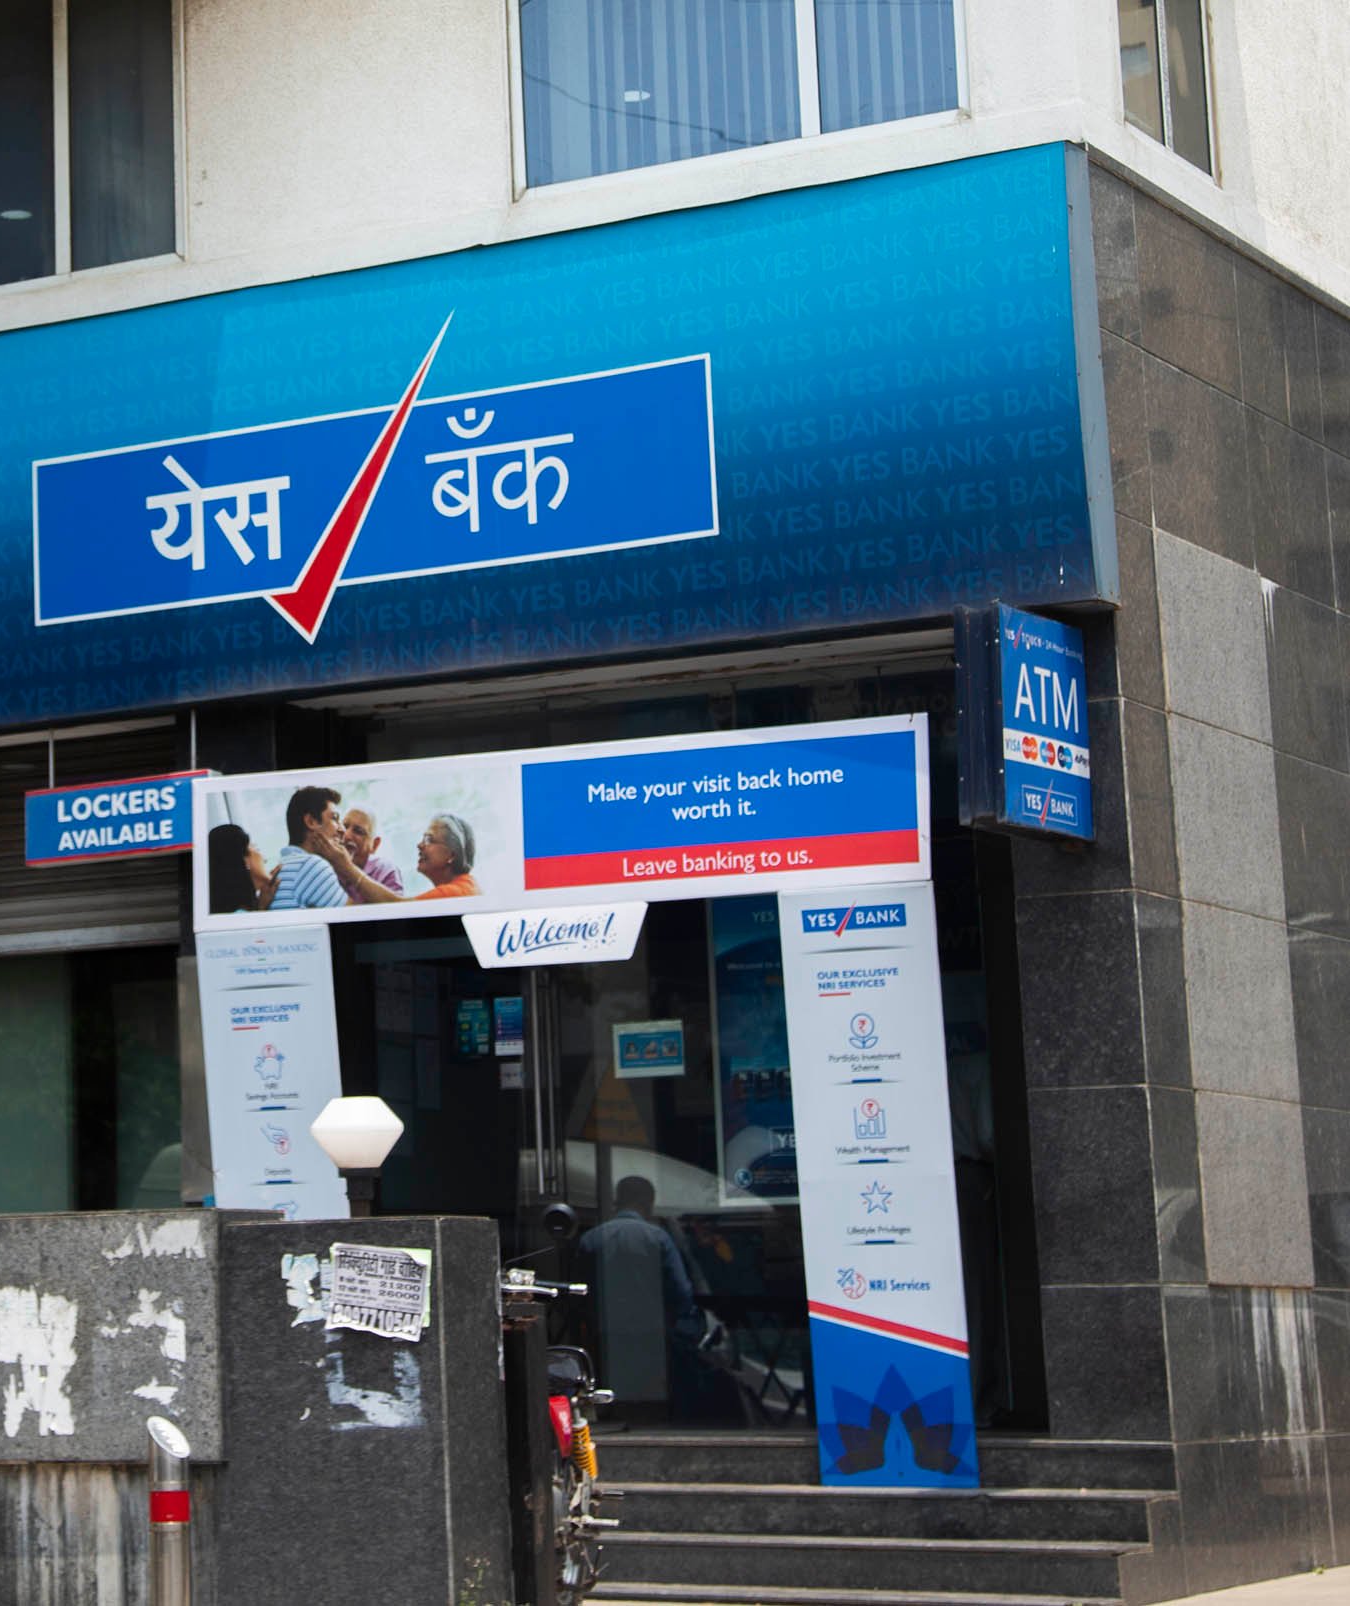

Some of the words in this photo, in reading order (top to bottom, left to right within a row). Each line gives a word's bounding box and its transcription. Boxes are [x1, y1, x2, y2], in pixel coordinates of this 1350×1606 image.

[752, 247, 811, 283] YES
[820, 230, 912, 272] BANK
[922, 218, 982, 255] YES
[723, 290, 812, 330] BANK
[822, 278, 881, 314] YES
[891, 261, 985, 303] BANK
[994, 249, 1057, 287] YES
[754, 332, 815, 368] YES
[824, 316, 916, 356] BANK
[926, 305, 987, 340] YES
[727, 374, 817, 415] BANK
[825, 363, 886, 400] YES
[895, 347, 990, 390] BANK
[998, 337, 1063, 375] YES
[759, 416, 820, 453] YES
[828, 401, 922, 443] BANK
[929, 391, 993, 428] YES
[732, 459, 823, 499] BANK
[830, 449, 891, 486] YES
[900, 435, 996, 476] BANK
[1002, 425, 1069, 462] YES
[146, 455, 290, 571] येस
[425, 408, 573, 533] बँक
[764, 503, 825, 538] YES
[833, 489, 928, 529] BANK
[935, 479, 999, 515] YES
[419, 588, 502, 625] BANK
[511, 580, 565, 613] YES
[574, 567, 662, 605] BANK
[670, 558, 728, 593] YES
[736, 546, 828, 585] BANK
[836, 537, 897, 572] YES
[905, 523, 1002, 564] BANK
[1010, 514, 1077, 551] YES
[607, 610, 662, 644] YES
[671, 598, 761, 636] BANK
[769, 589, 830, 624] YES
[838, 577, 934, 616] BANK
[1014, 663, 1079, 734] ATM
[1005, 738, 1021, 753] VISA
[588, 782, 637, 803] Make
[642, 780, 687, 805] your
[692, 774, 732, 794] visit
[737, 769, 782, 790] back
[788, 765, 844, 785] home
[57, 785, 176, 823] LOCKERS
[672, 800, 731, 821] worth
[738, 798, 756, 817] it.
[1025, 792, 1042, 811] YES
[1051, 799, 1074, 818] BANK
[58, 819, 173, 852] AVAILABLE
[623, 857, 677, 878] Leave
[682, 850, 756, 874] banking
[760, 849, 781, 867] to
[787, 848, 814, 867] us.
[751, 911, 776, 924] YES
[807, 912, 837, 928] YES
[855, 909, 901, 925] BANK
[495, 912, 615, 959] Welcome!
[817, 970, 840, 980] OUR
[842, 967, 899, 979] EXCLUSIVE
[818, 981, 836, 991] NRI
[838, 979, 885, 990] SERVICES
[230, 1006, 249, 1015] OUR
[252, 1003, 300, 1014] EXCLUSIVE
[249, 1014, 290, 1024] SERVICES
[378, 1289, 420, 1301] 26000
[379, 1280, 421, 1293] 21200
[869, 1280, 887, 1291] NRI
[890, 1279, 930, 1291] Services
